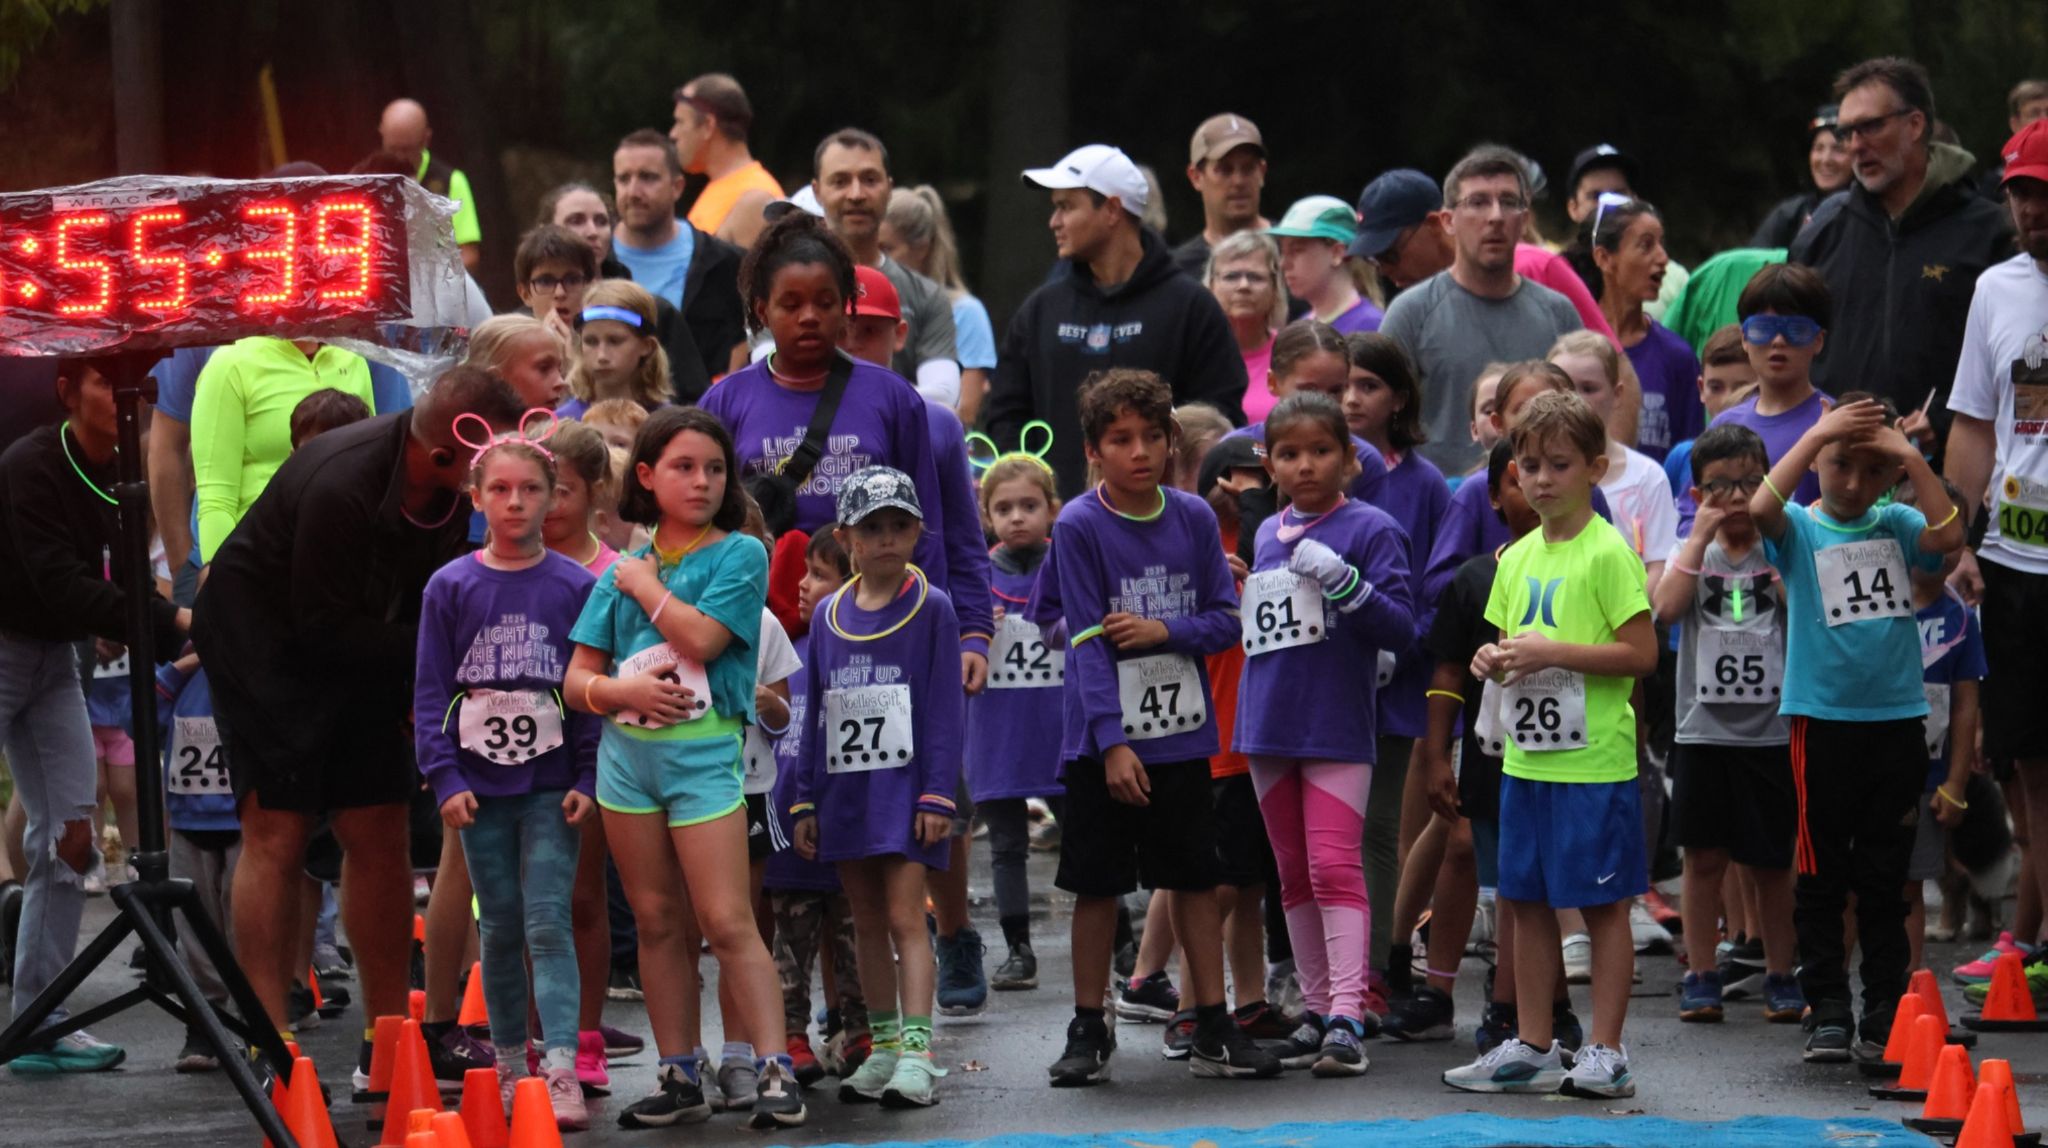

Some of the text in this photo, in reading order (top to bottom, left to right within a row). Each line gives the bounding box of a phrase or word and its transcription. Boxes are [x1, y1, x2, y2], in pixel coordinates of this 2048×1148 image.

[1058, 322, 1087, 339] BEST
[1113, 321, 1142, 339] EVER
[763, 434, 860, 457] LIG UP
[1121, 573, 1190, 596] LIGHT UP
[1843, 567, 1895, 603] 14
[1109, 595, 1145, 613] THE
[1255, 595, 1302, 634] 61
[474, 621, 549, 645] LIGHT UP
[501, 640, 558, 663] NIGHT!
[1005, 641, 1051, 670] 42
[455, 659, 563, 682] FOR NOELLE
[830, 665, 902, 688] LIGHT UP
[1715, 654, 1765, 686] 65
[1140, 683, 1181, 719] 47
[1515, 697, 1561, 731] 26
[484, 714, 538, 750] 39
[839, 716, 886, 753] 27
[179, 745, 226, 777] 24
